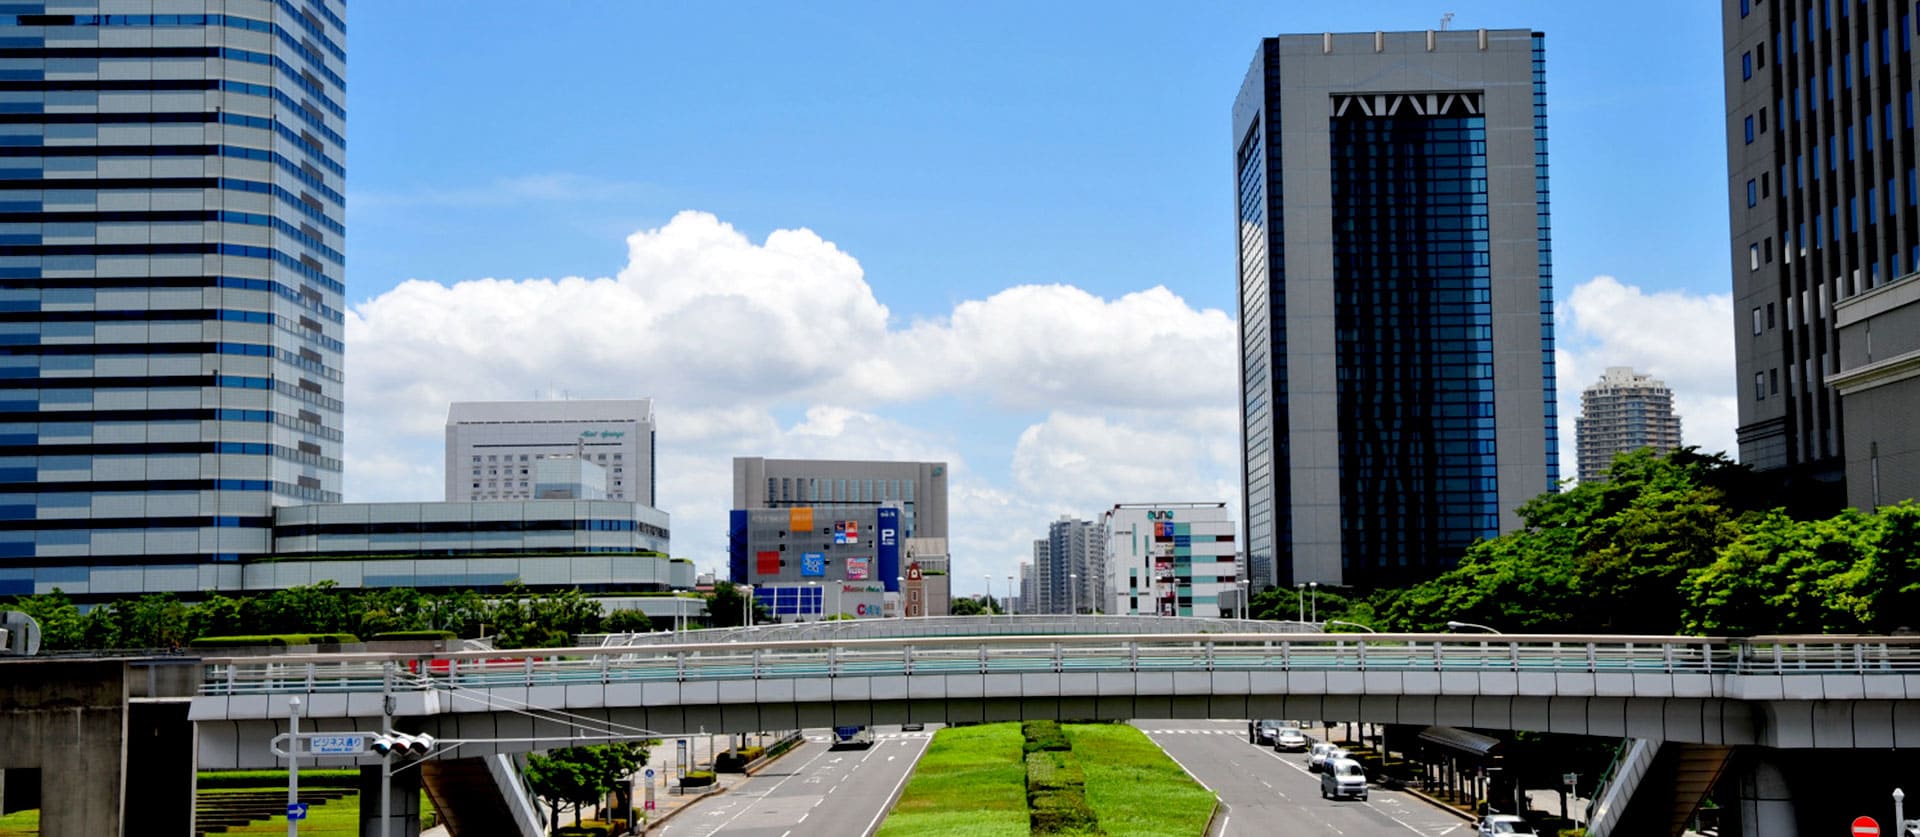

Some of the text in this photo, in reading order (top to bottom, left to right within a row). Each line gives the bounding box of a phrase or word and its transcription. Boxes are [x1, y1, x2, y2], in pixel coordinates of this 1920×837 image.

[882, 528, 895, 543] P
[313, 738, 361, 747] ビジネス通り
